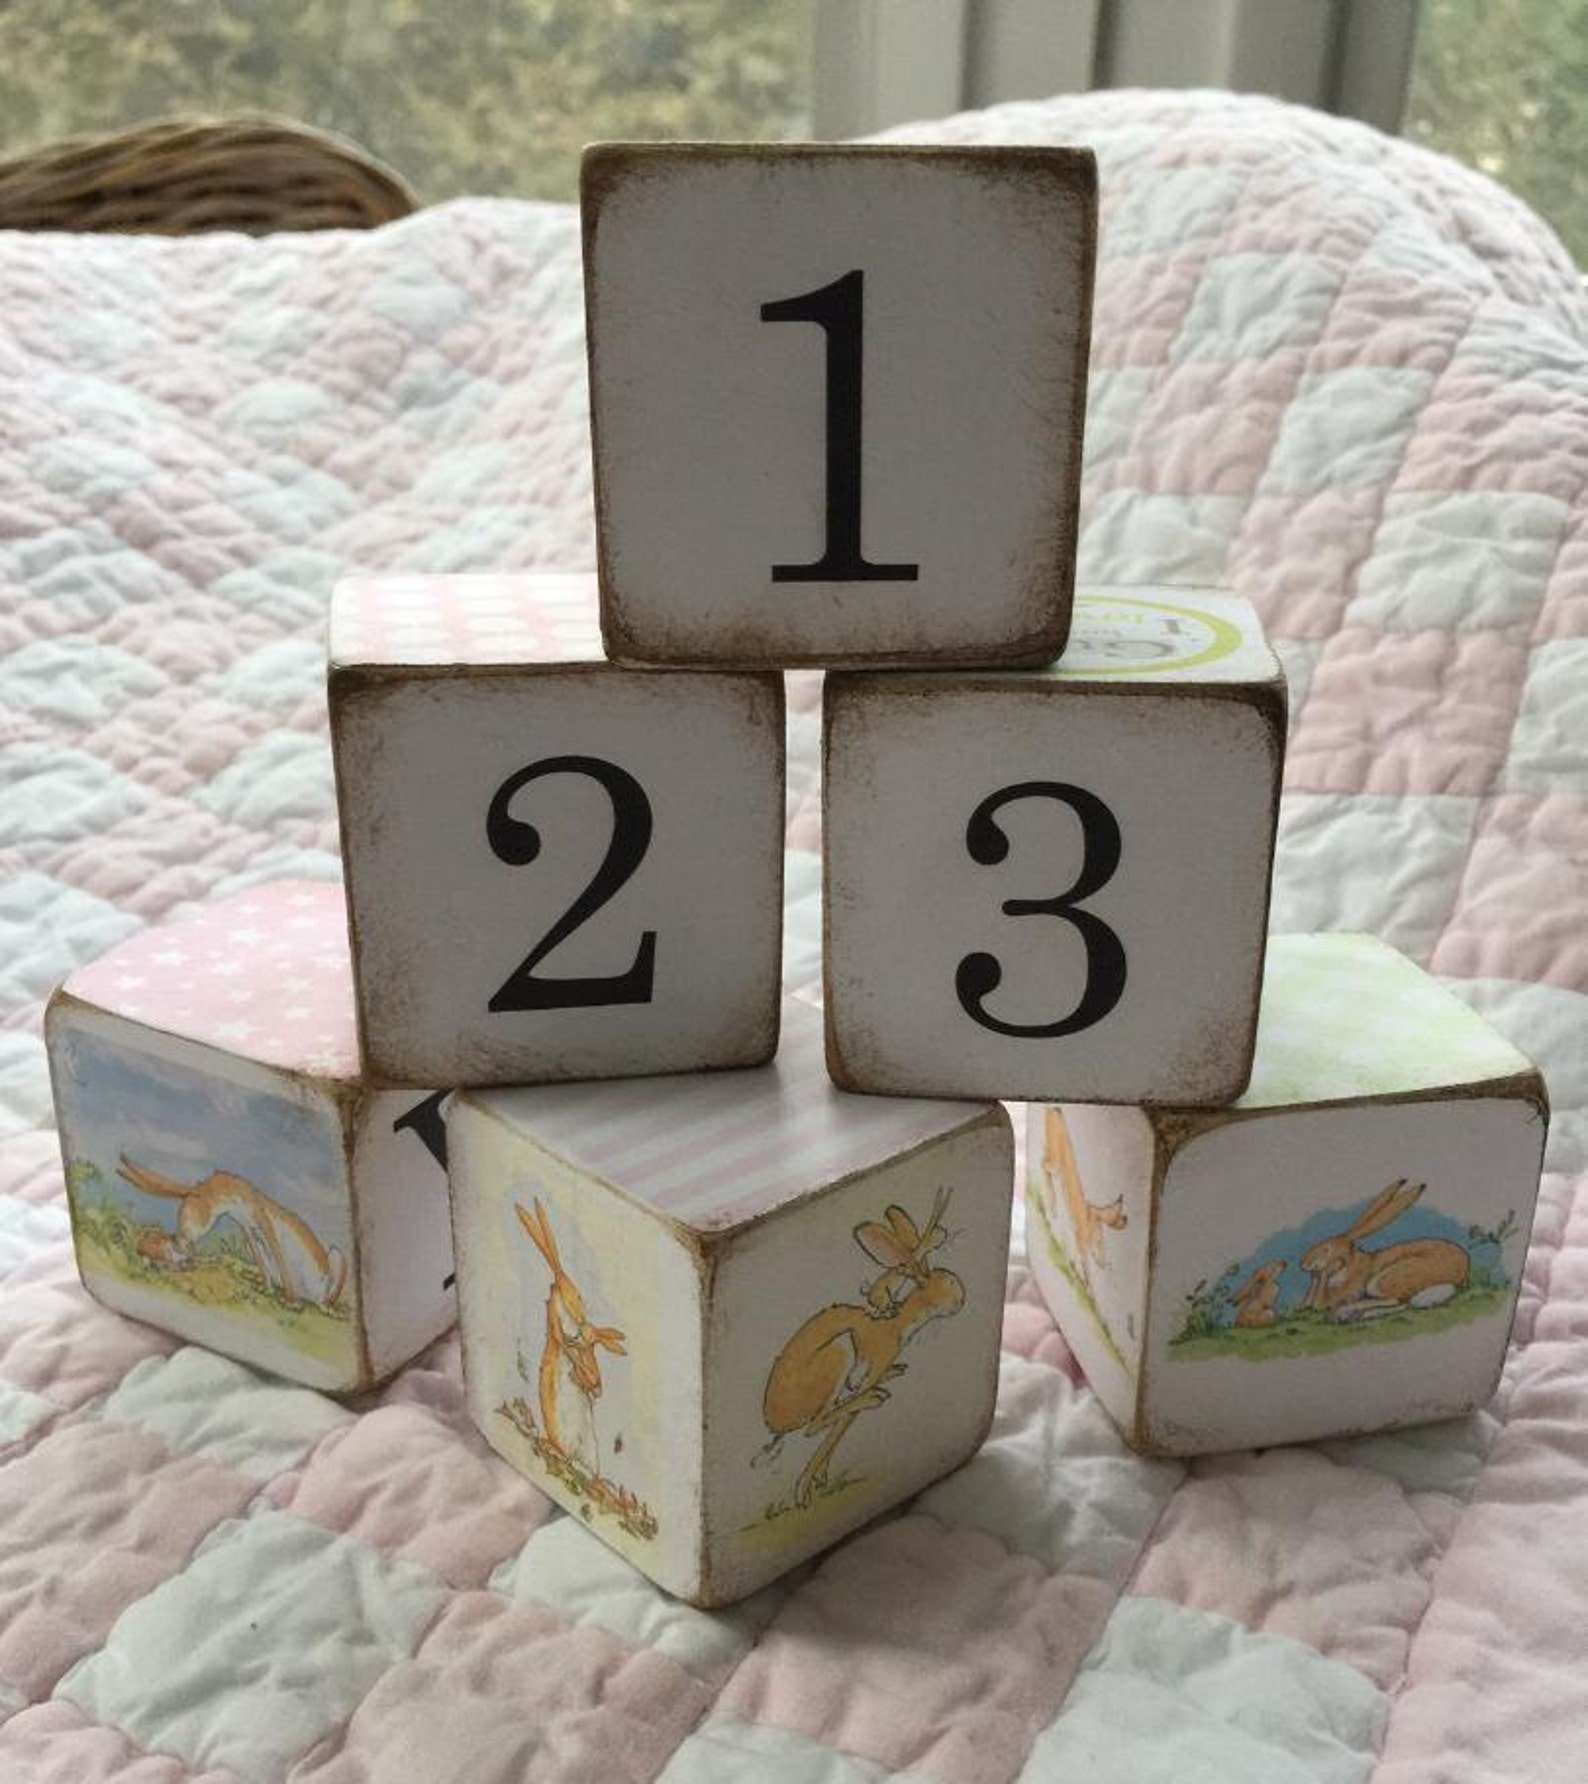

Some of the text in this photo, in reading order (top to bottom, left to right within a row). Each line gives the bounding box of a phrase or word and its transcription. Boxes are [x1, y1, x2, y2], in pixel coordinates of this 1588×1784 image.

[760, 270, 919, 583] 1
[486, 755, 657, 1013] 2
[955, 782, 1127, 1038] 3
